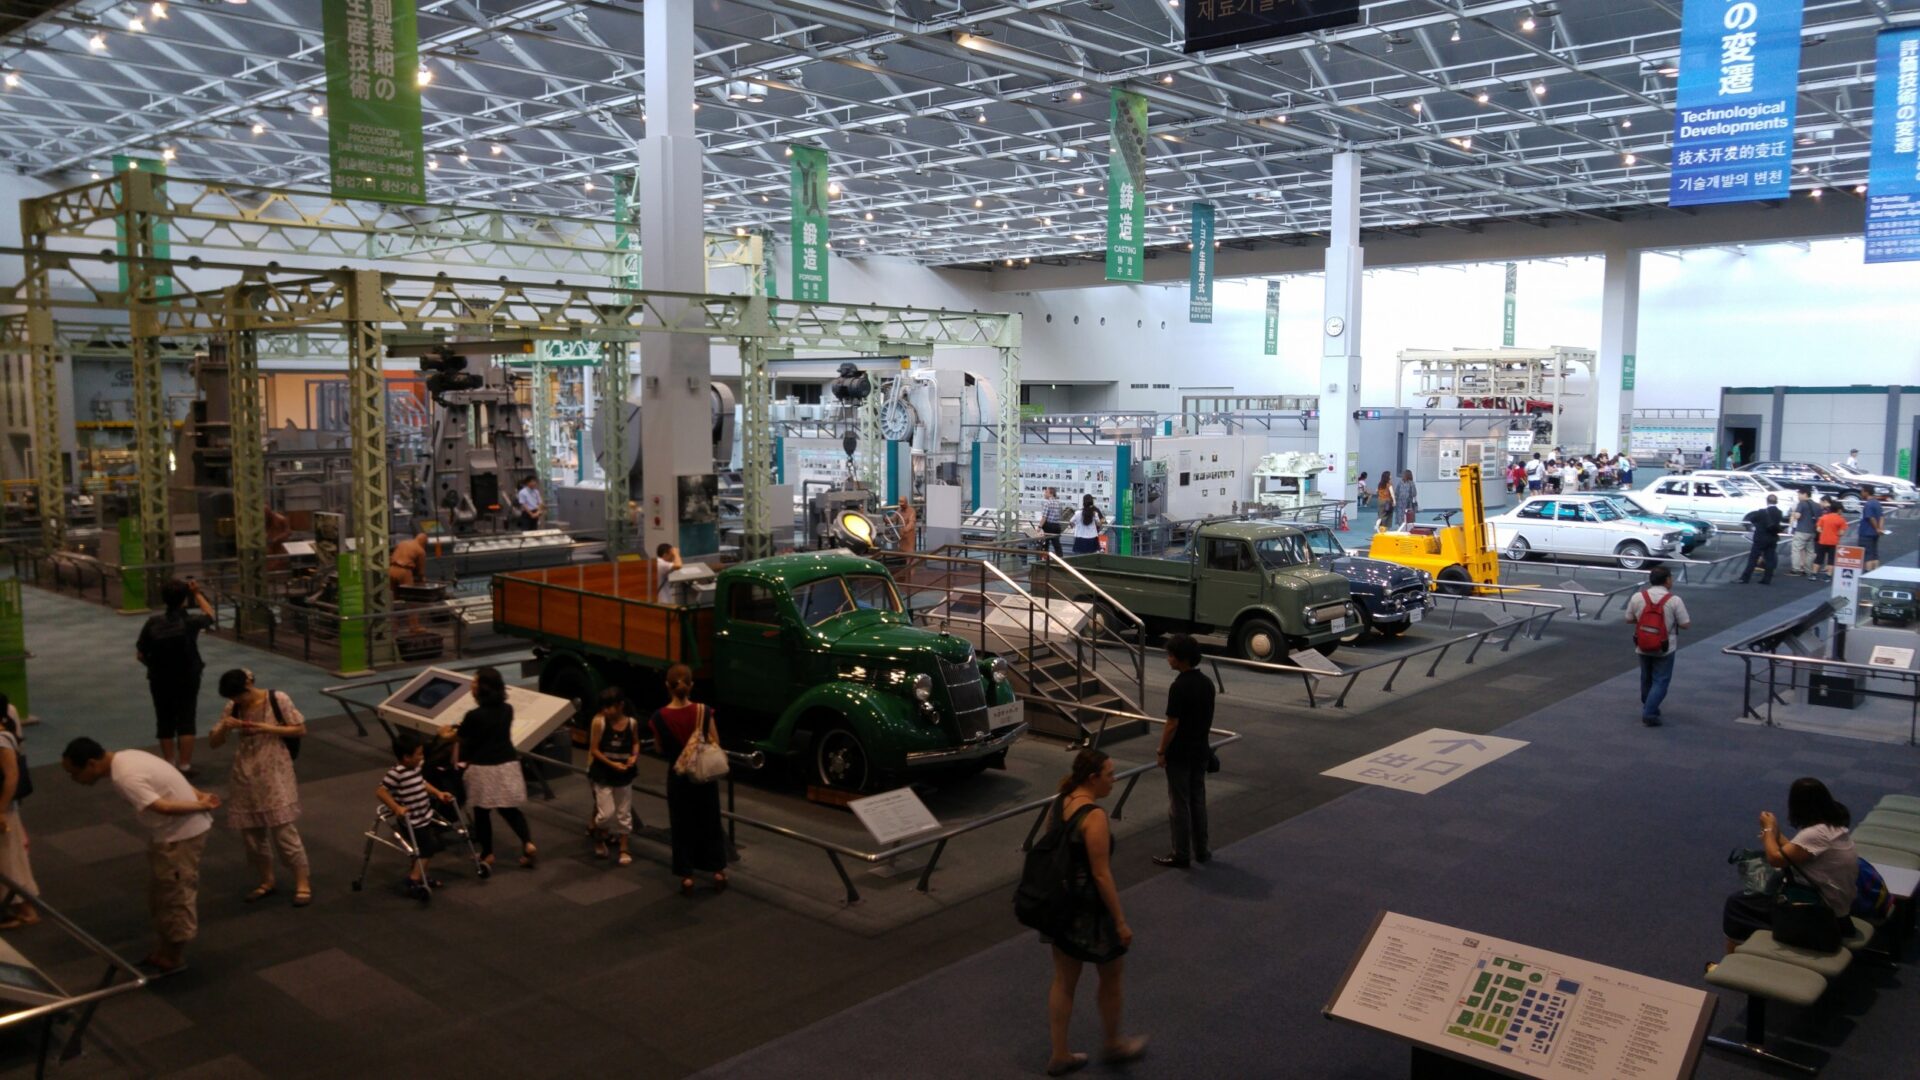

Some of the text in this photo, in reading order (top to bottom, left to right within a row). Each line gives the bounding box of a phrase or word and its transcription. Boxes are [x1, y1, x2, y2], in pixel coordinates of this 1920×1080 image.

[1197, 0, 1296, 21] 재료기술
[346, 0, 371, 100] 生産技術
[371, 0, 396, 100] 創業期の
[1718, 2, 1758, 96] の変遷
[1682, 101, 1786, 124] Technological
[1680, 117, 1789, 138] Developments
[1678, 141, 1787, 166] 技术开发的变迁
[1679, 169, 1783, 192] 기술개발의 변천
[1114, 245, 1137, 255] CASTING
[1368, 752, 1464, 776] 出口
[1358, 768, 1417, 784] Exit
